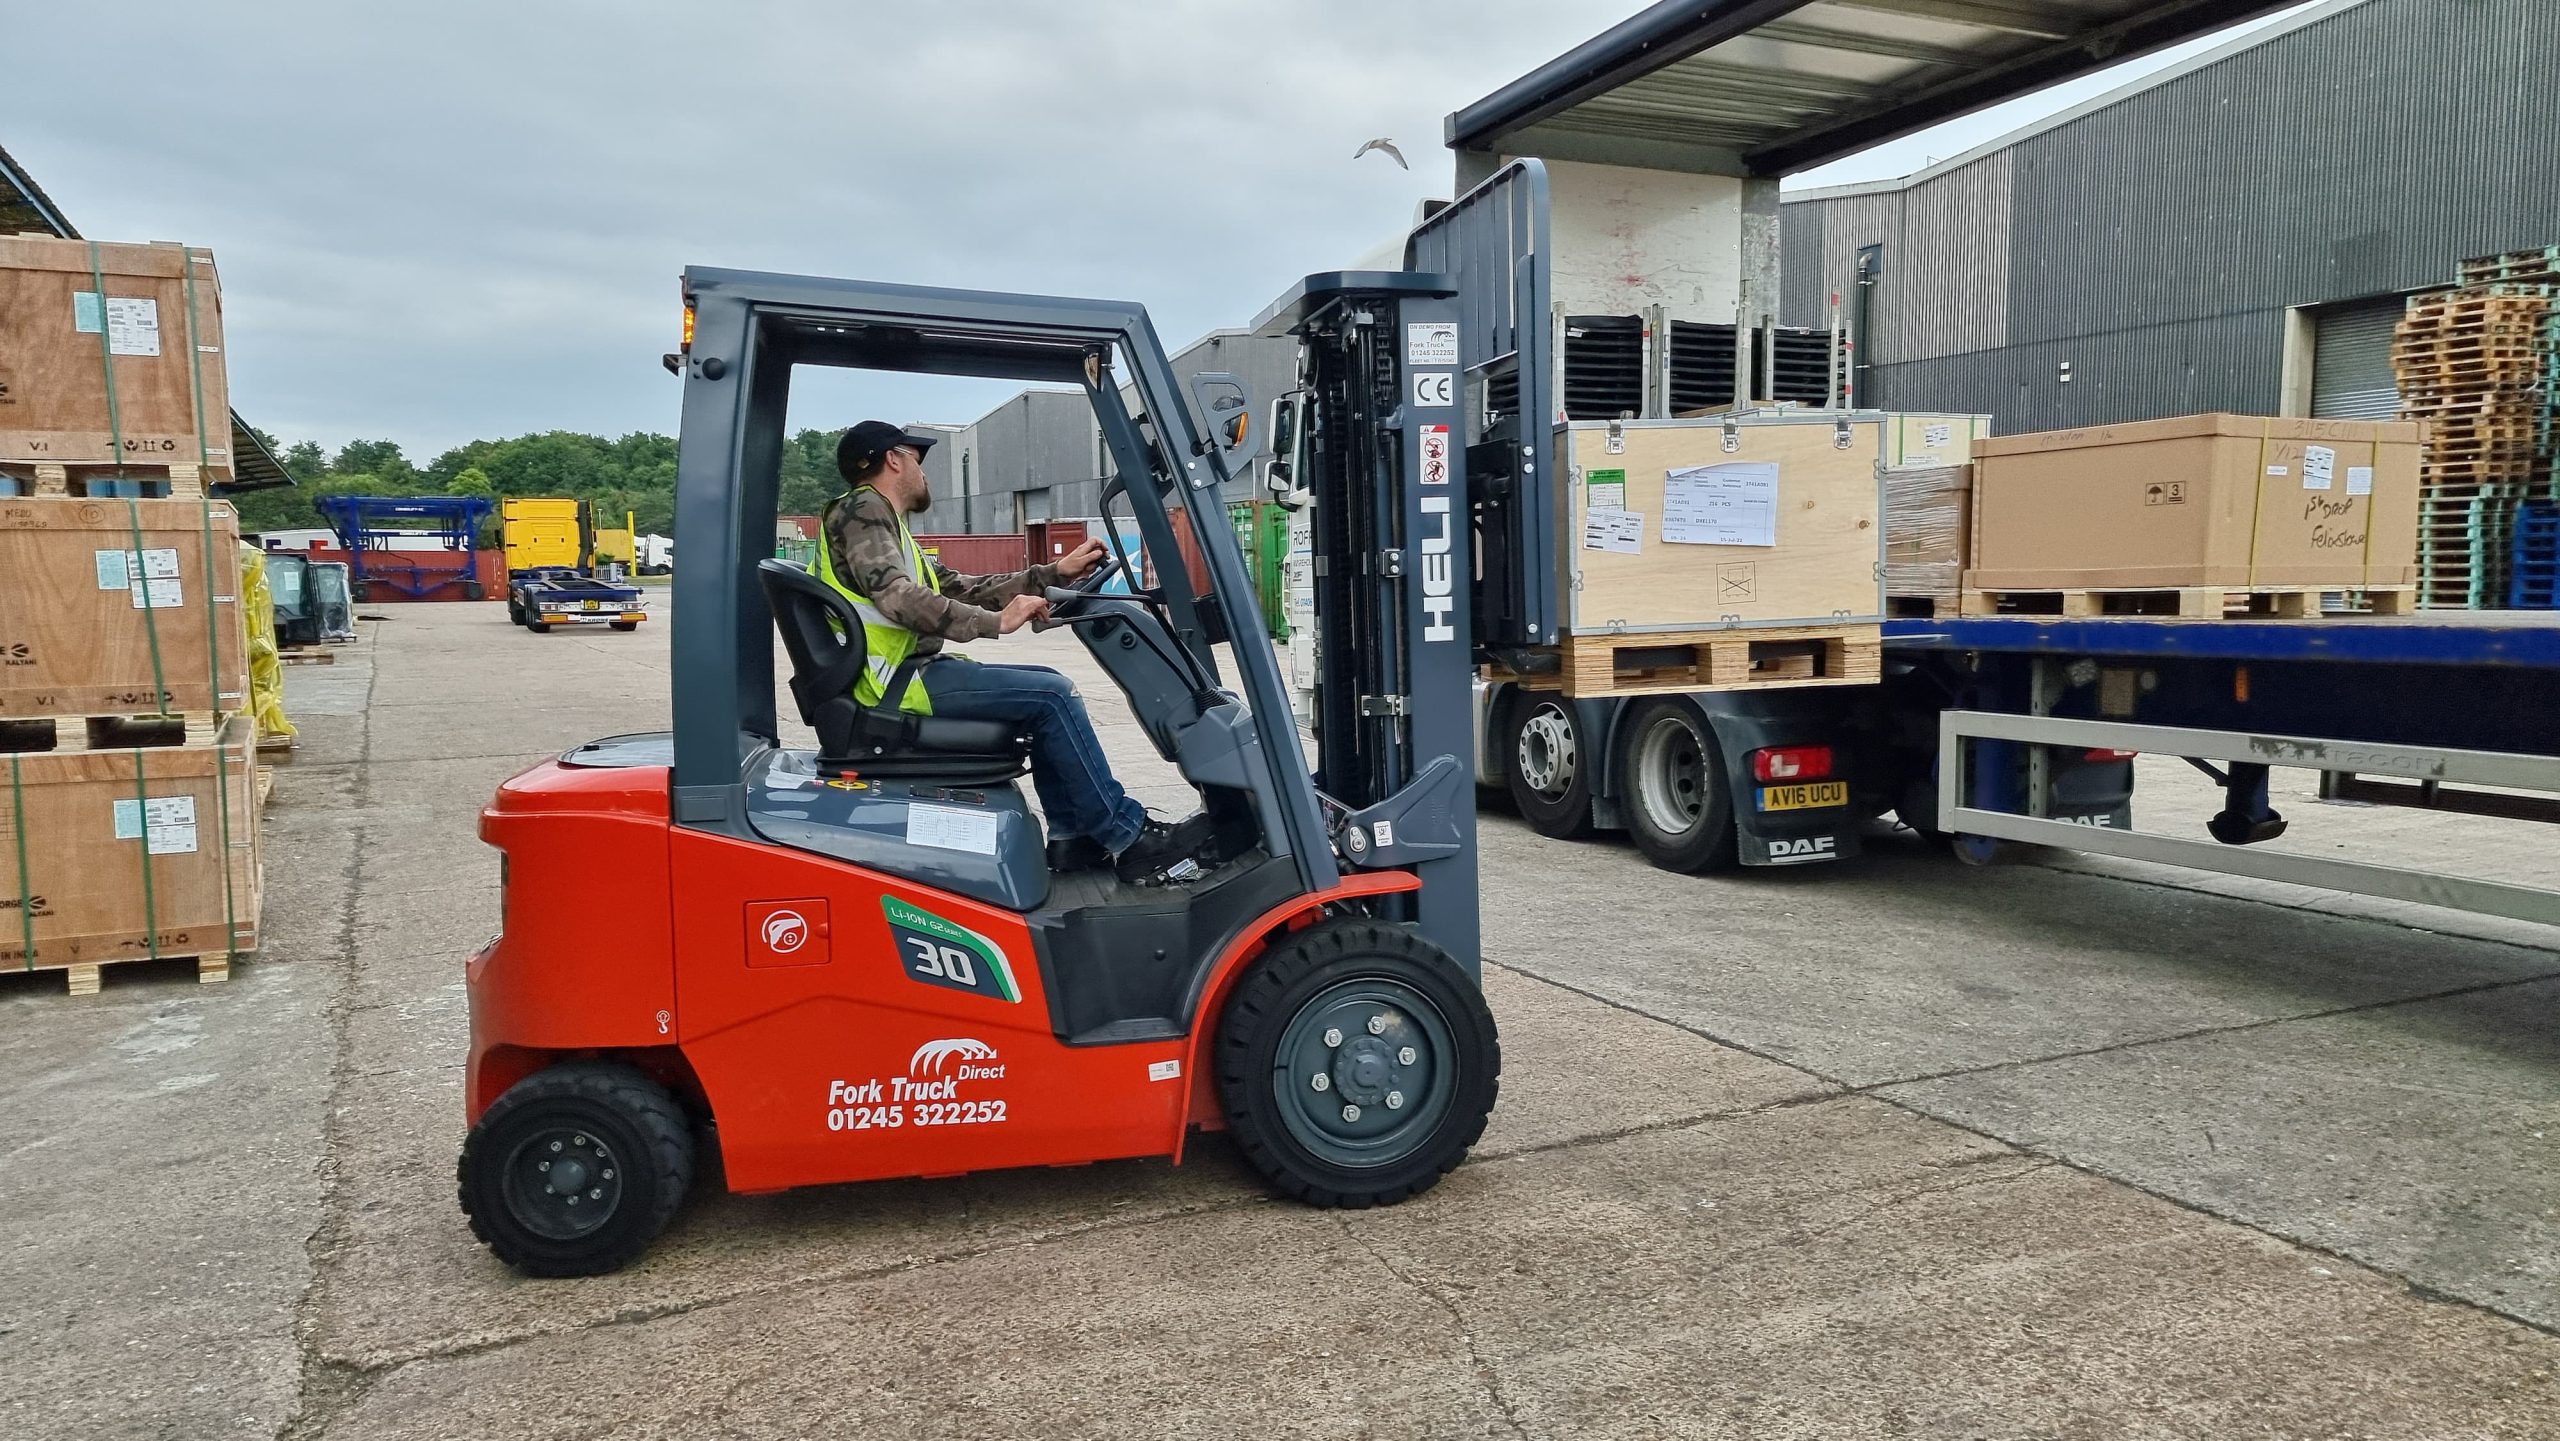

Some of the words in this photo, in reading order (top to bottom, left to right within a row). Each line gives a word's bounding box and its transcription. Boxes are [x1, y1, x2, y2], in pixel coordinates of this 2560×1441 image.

[1417, 377, 1450, 402] CE
[2171, 483, 2180, 496] 3
[1420, 496, 1454, 642] HELI
[1771, 786, 1806, 807] AV16
[1810, 783, 1841, 803] UCU
[1768, 836, 1835, 856] DAF
[0, 898, 24, 909] ORGE
[906, 936, 977, 986] 30
[957, 1064, 1006, 1081] Direct
[827, 1078, 884, 1106] Fork
[890, 1074, 959, 1102] Truck
[827, 1105, 905, 1131] 01245
[913, 1099, 1007, 1127] 322252
